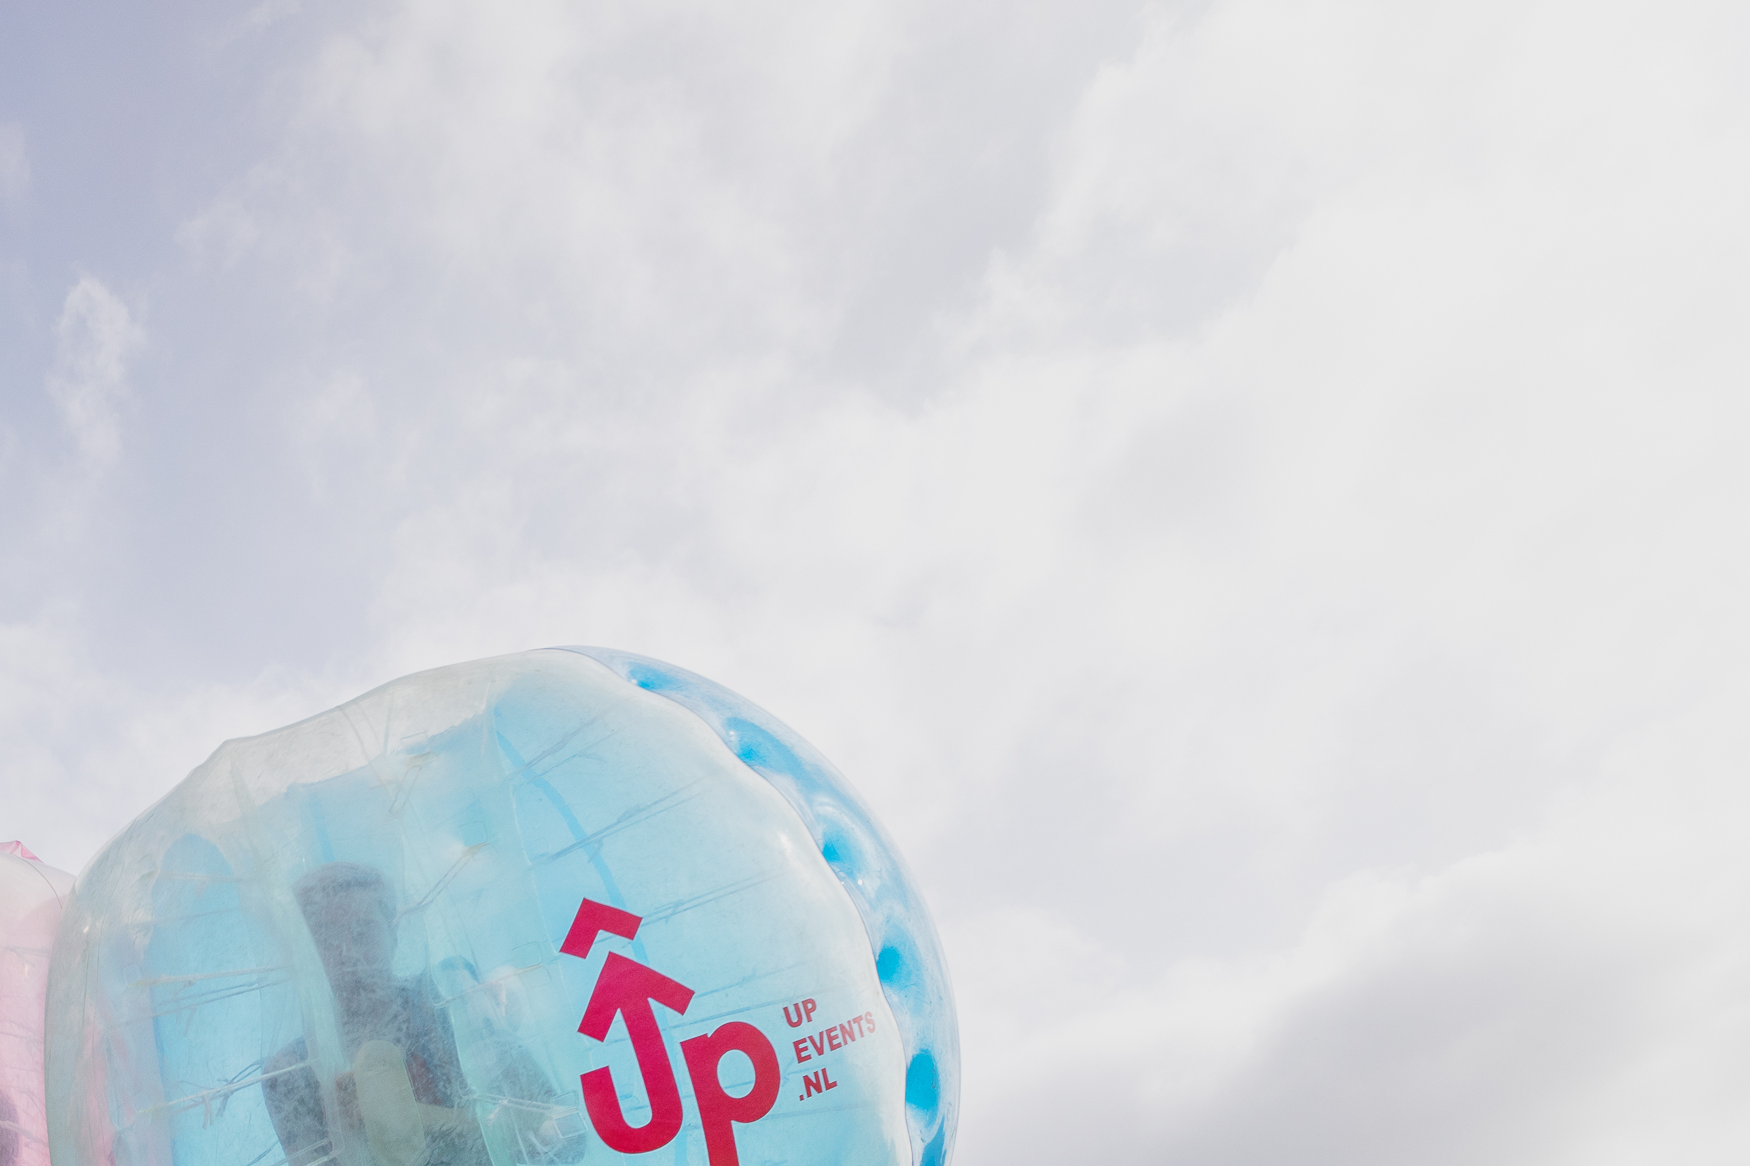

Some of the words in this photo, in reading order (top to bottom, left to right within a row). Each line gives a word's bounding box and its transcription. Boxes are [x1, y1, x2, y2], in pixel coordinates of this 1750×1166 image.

[783, 998, 817, 1028] UP
[793, 1011, 876, 1063] EVENTS
[799, 1068, 837, 1101] .NL
